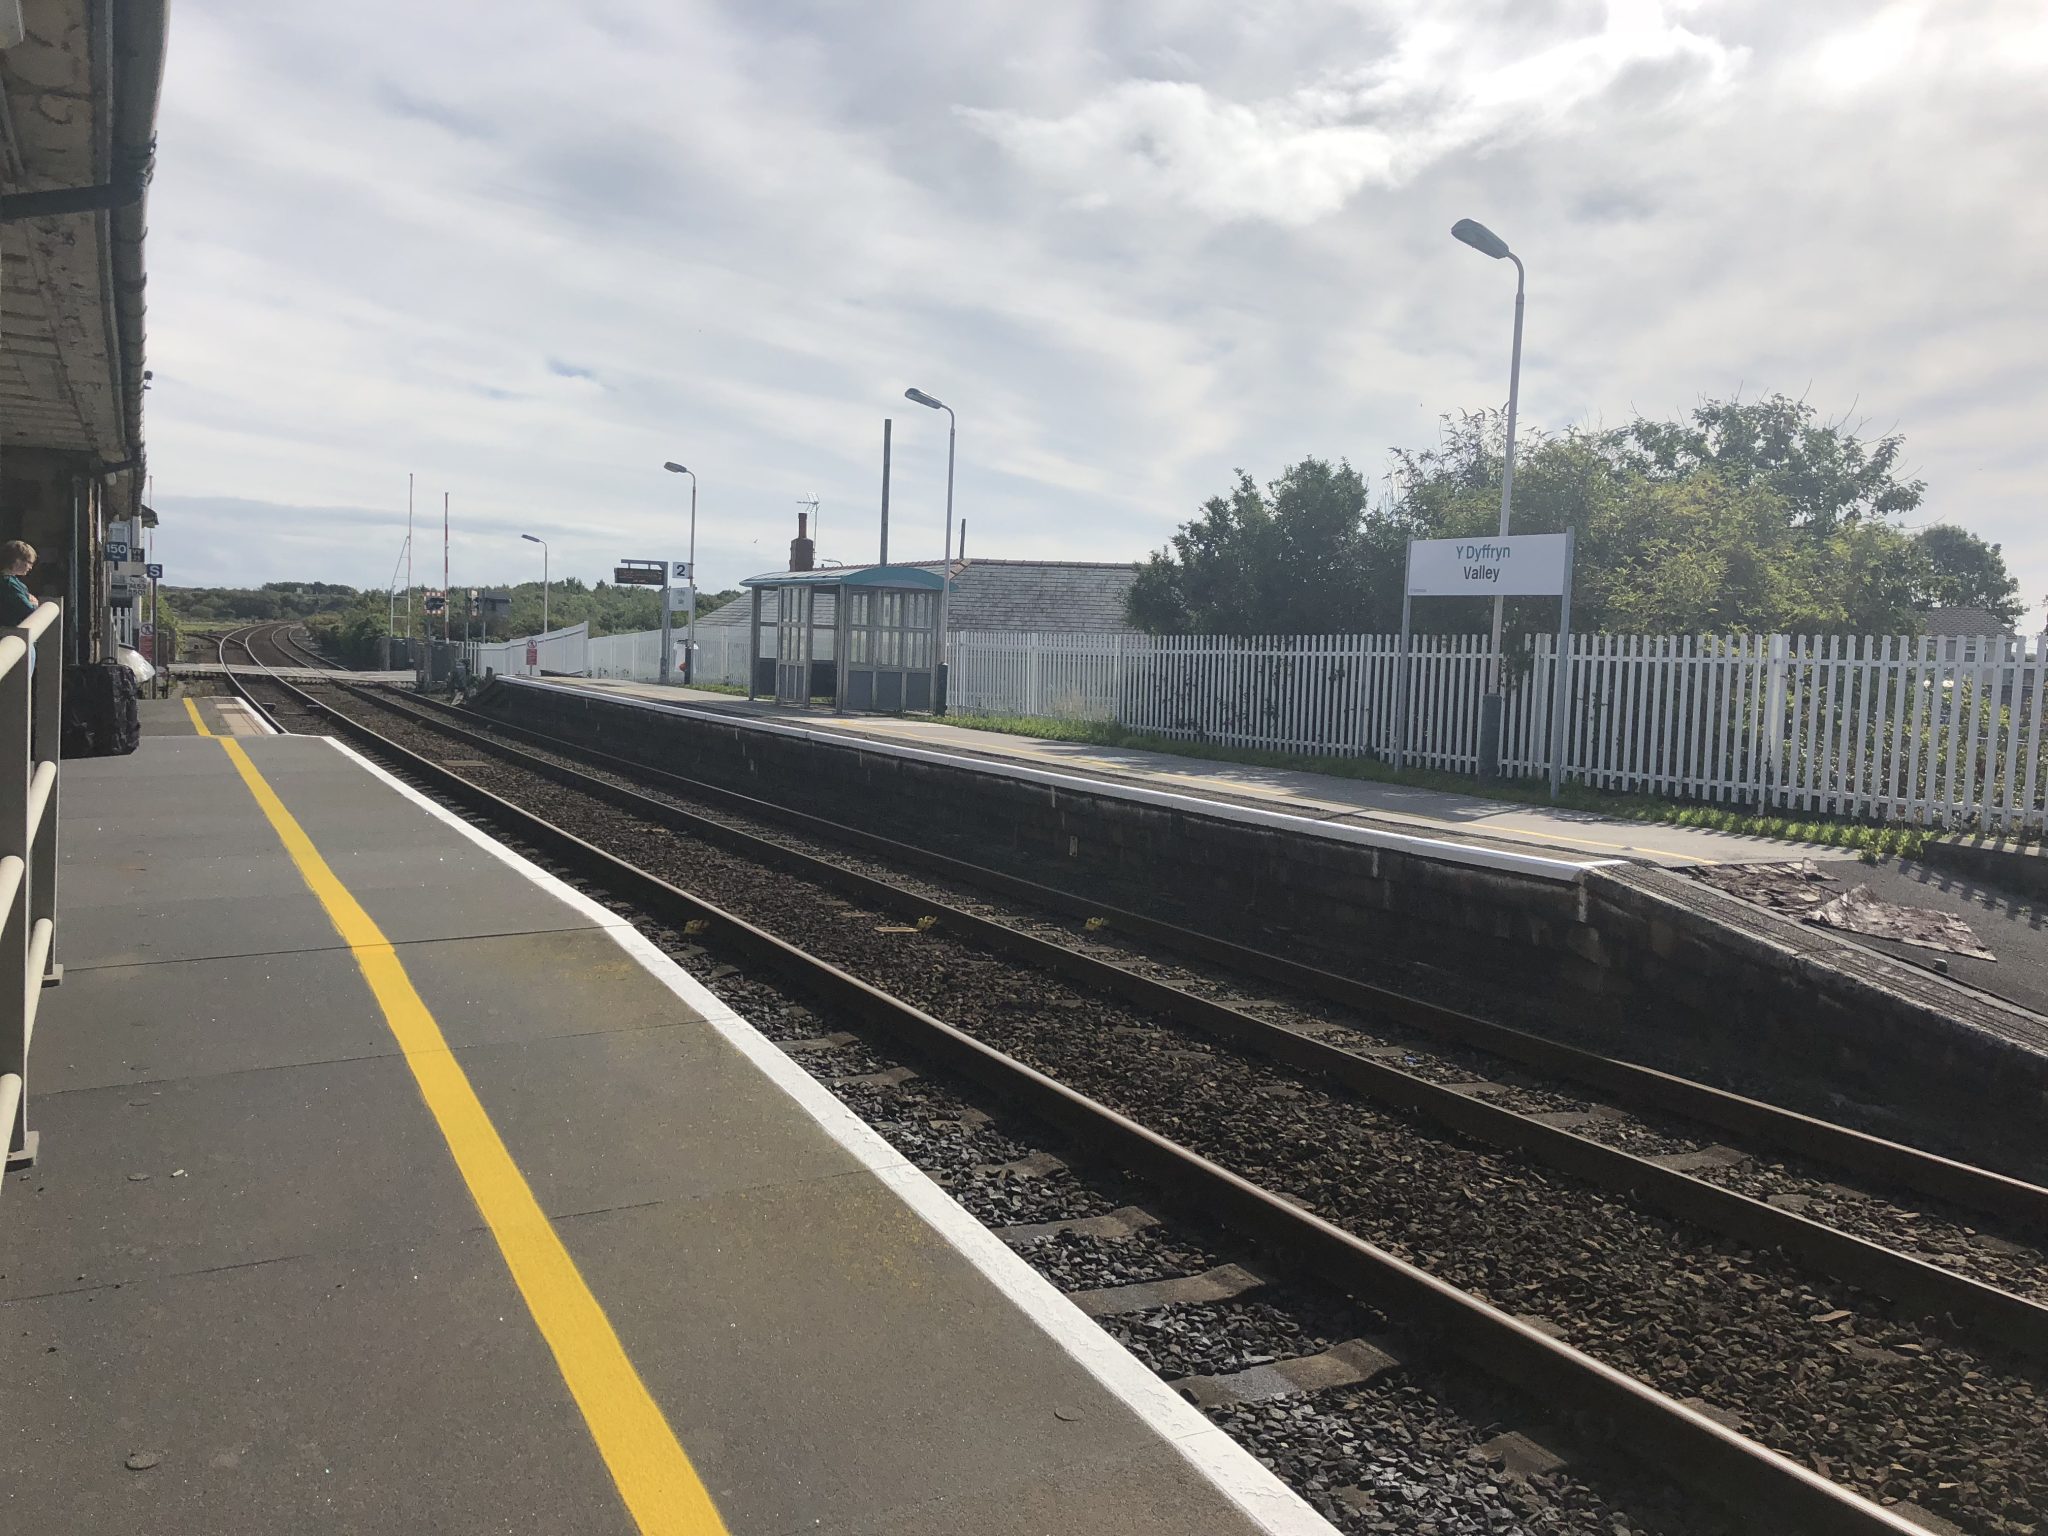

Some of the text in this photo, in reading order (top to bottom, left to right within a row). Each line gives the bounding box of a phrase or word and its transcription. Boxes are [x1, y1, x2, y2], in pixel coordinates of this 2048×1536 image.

[106, 544, 127, 554] 150
[1456, 544, 1511, 562] Y Dyffryn
[149, 565, 160, 577] S
[676, 564, 686, 577] 2
[1463, 565, 1500, 583] Valley
